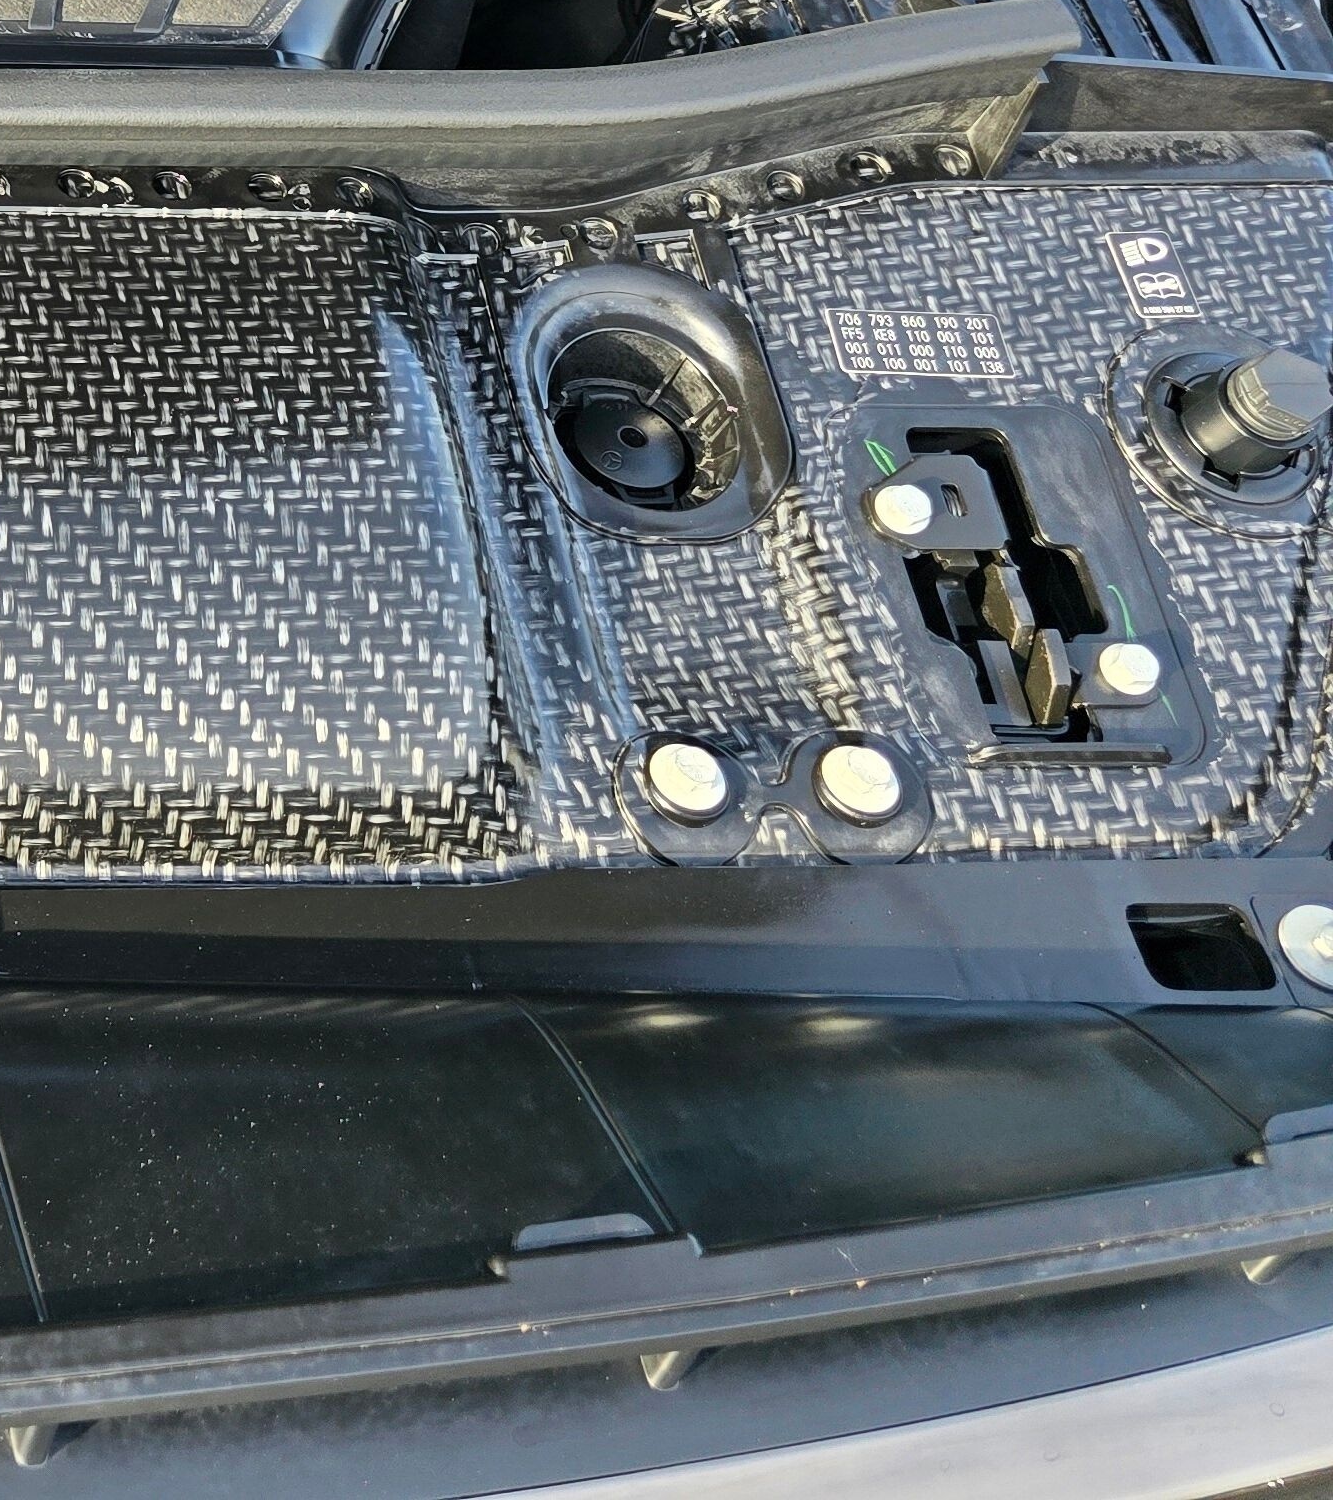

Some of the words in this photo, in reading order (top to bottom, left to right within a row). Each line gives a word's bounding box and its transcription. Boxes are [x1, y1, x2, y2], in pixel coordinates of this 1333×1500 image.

[836, 313, 861, 326] 706
[868, 314, 894, 327] 793
[901, 315, 926, 328] 860
[934, 317, 957, 329] 190
[965, 318, 990, 330] 201
[841, 327, 865, 340] FF5
[873, 329, 897, 341] KE8
[906, 330, 930, 342] 110
[937, 332, 961, 343] 001
[971, 332, 994, 344] 101
[845, 342, 869, 354] 001
[877, 344, 901, 355] 011
[909, 344, 934, 357] 000
[943, 346, 966, 358] 110
[974, 347, 999, 359] 000
[850, 357, 874, 369] 100
[883, 358, 907, 370] 100
[914, 359, 937, 371] 001
[947, 360, 970, 373] 101
[980, 361, 1004, 374] 138
